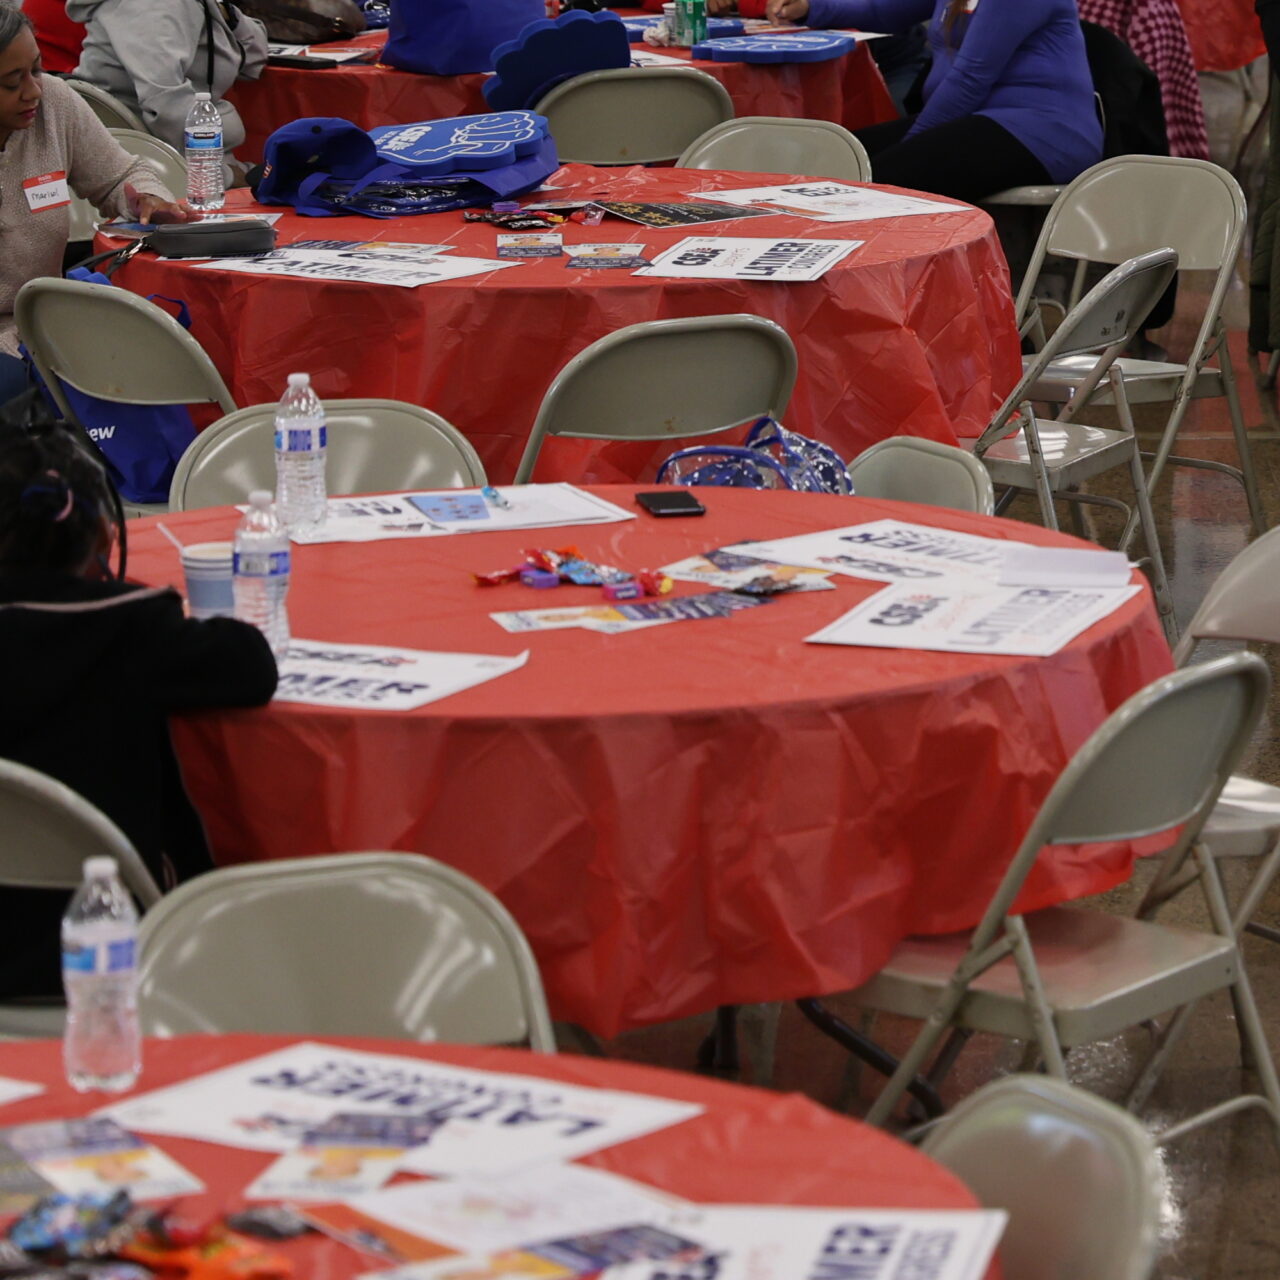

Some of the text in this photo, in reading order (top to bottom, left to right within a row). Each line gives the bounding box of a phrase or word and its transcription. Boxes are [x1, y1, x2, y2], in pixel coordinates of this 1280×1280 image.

[338, 252, 446, 265] CSEA
[672, 247, 726, 267] CSEA
[736, 241, 814, 276] LATIMER
[787, 243, 840, 270] CONGRESS
[245, 257, 442, 279] LATIMER
[88, 425, 116, 441] ew
[867, 594, 949, 627] CSEA
